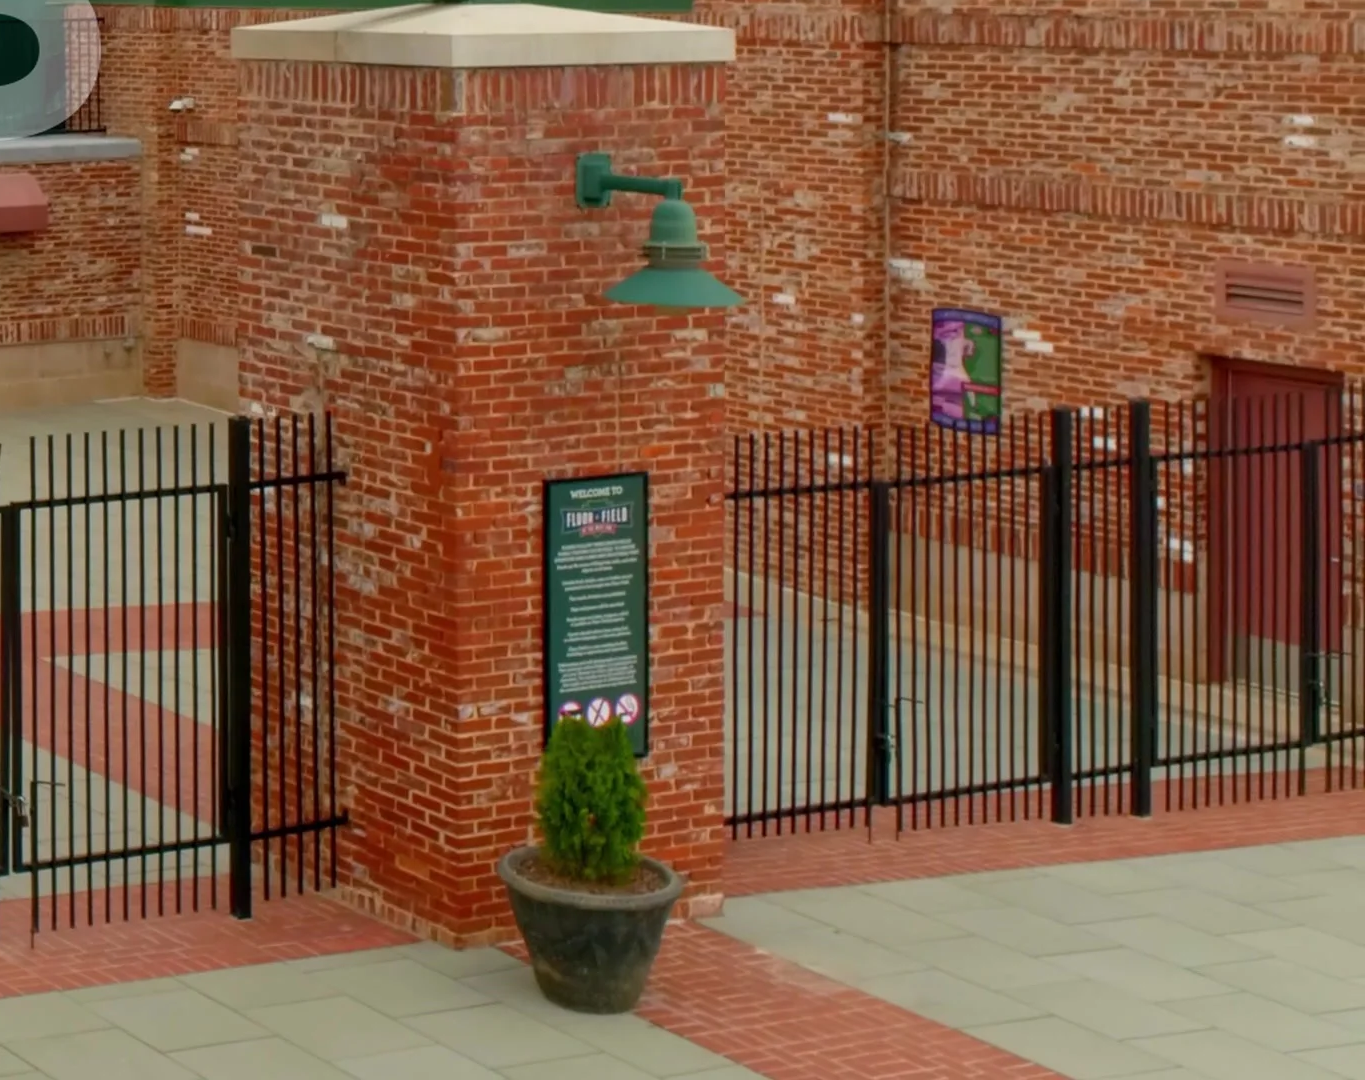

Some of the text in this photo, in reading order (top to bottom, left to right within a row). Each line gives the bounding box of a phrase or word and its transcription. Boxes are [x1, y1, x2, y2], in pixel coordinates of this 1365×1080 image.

[570, 485, 623, 499] WELCOME TO
[566, 507, 628, 528] FLUOR FIELD
